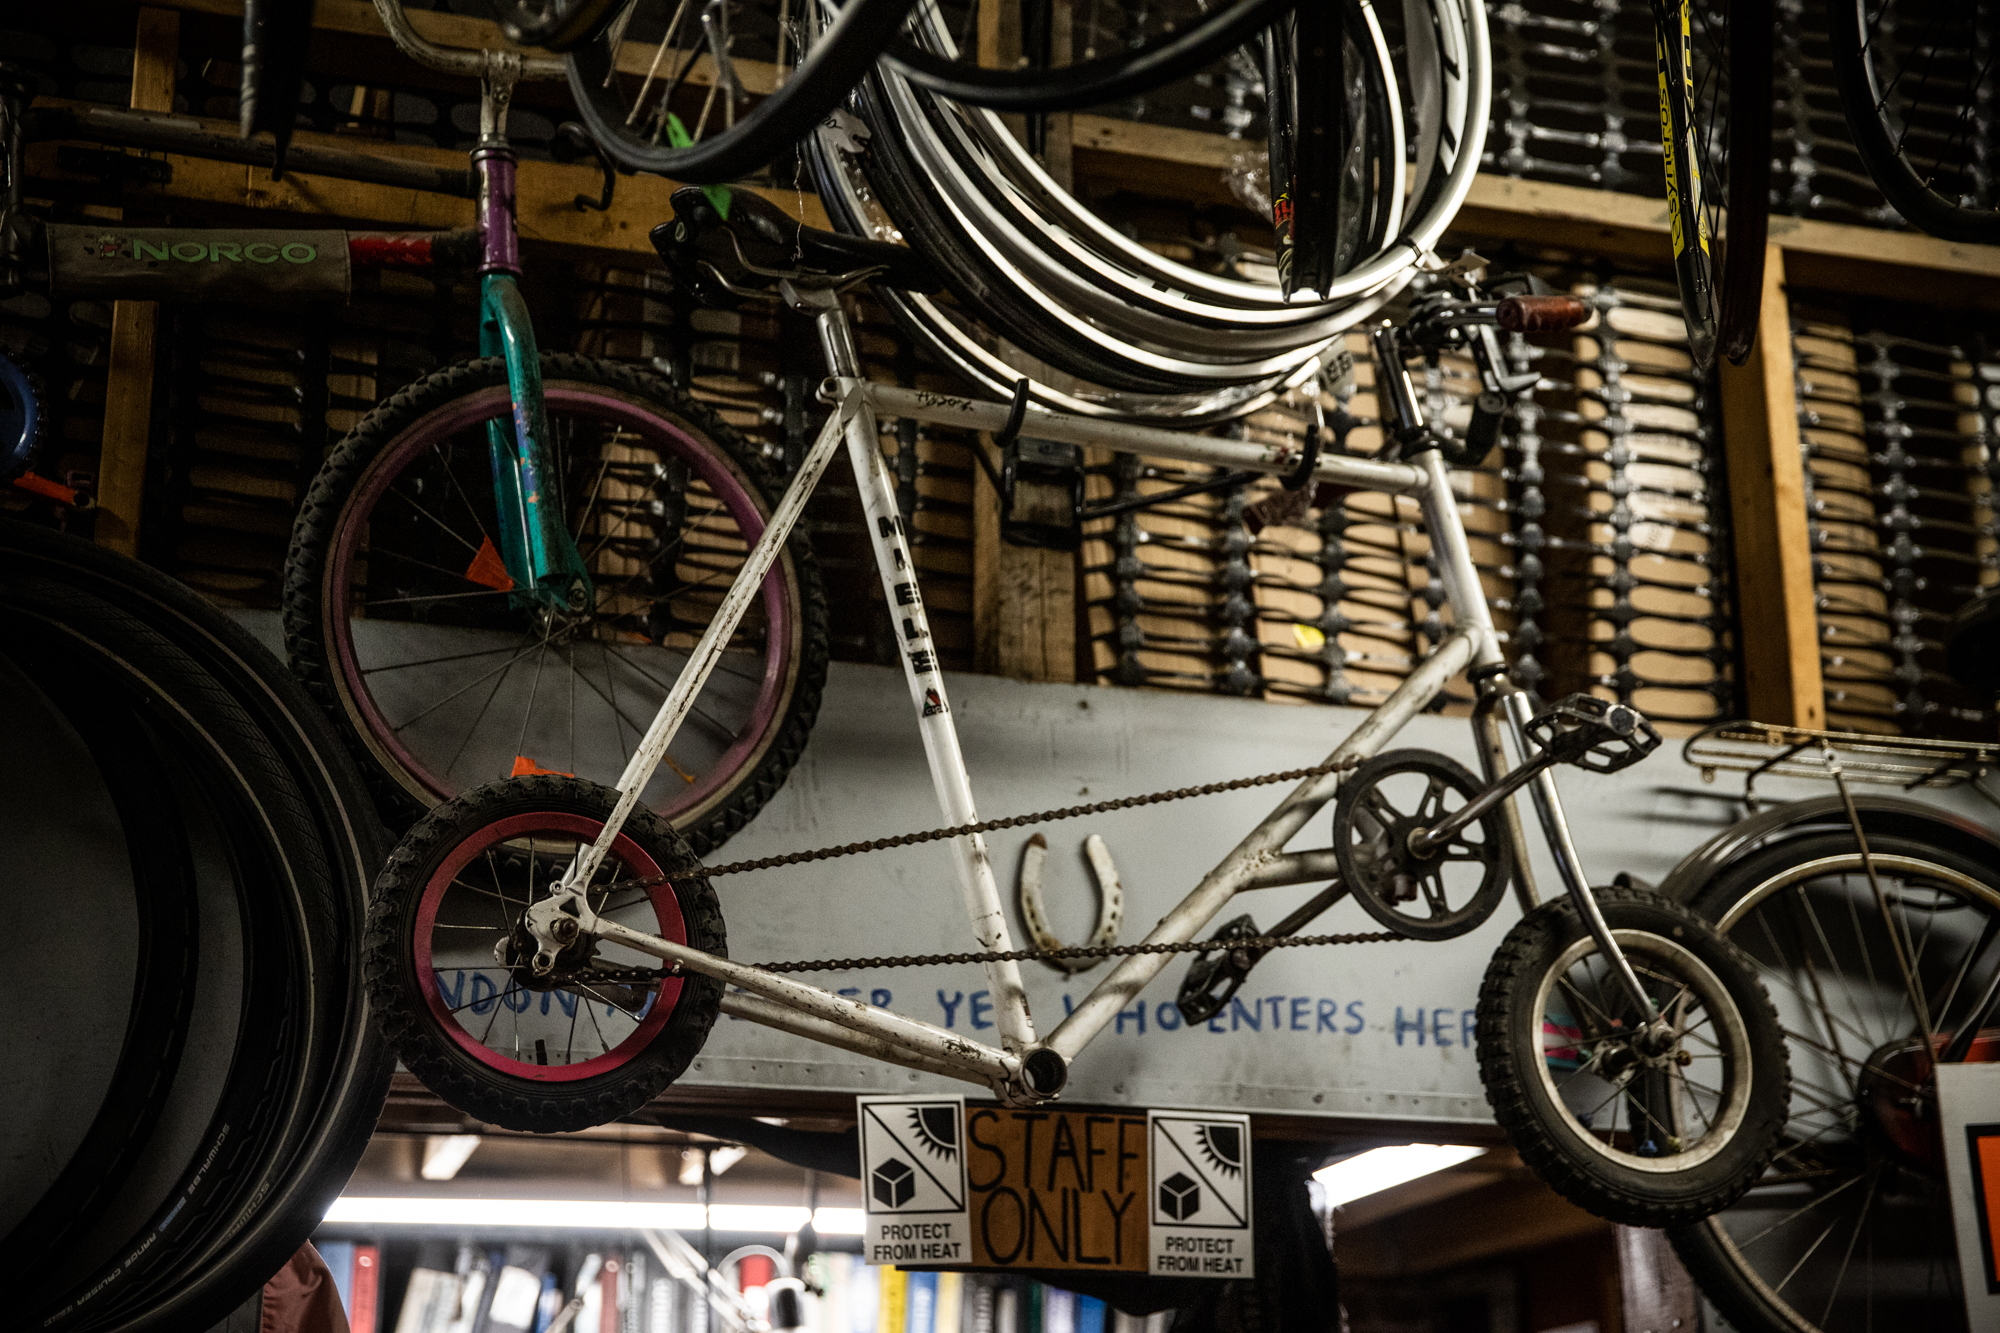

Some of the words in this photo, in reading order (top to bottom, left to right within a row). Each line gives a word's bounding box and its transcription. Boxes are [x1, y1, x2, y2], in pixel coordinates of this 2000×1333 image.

[1660, 87, 1680, 215] syncros
[132, 238, 317, 264] NORCO
[877, 515, 937, 674] MIELE
[937, 988, 994, 1029] YE
[1063, 994, 1181, 1035] HO
[1207, 995, 1364, 1035] ENTERS
[188, 1122, 231, 1195] SCHWALBE
[968, 1109, 1147, 1193] STAFF
[881, 1223, 951, 1240] PROTECT
[982, 1186, 1135, 1265] ONLY
[1166, 1236, 1234, 1253] PROTECT
[873, 1245, 917, 1260] FROM
[921, 1243, 961, 1259] HEAT
[1157, 1256, 1200, 1272] FROM
[1204, 1257, 1244, 1273] HEAT
